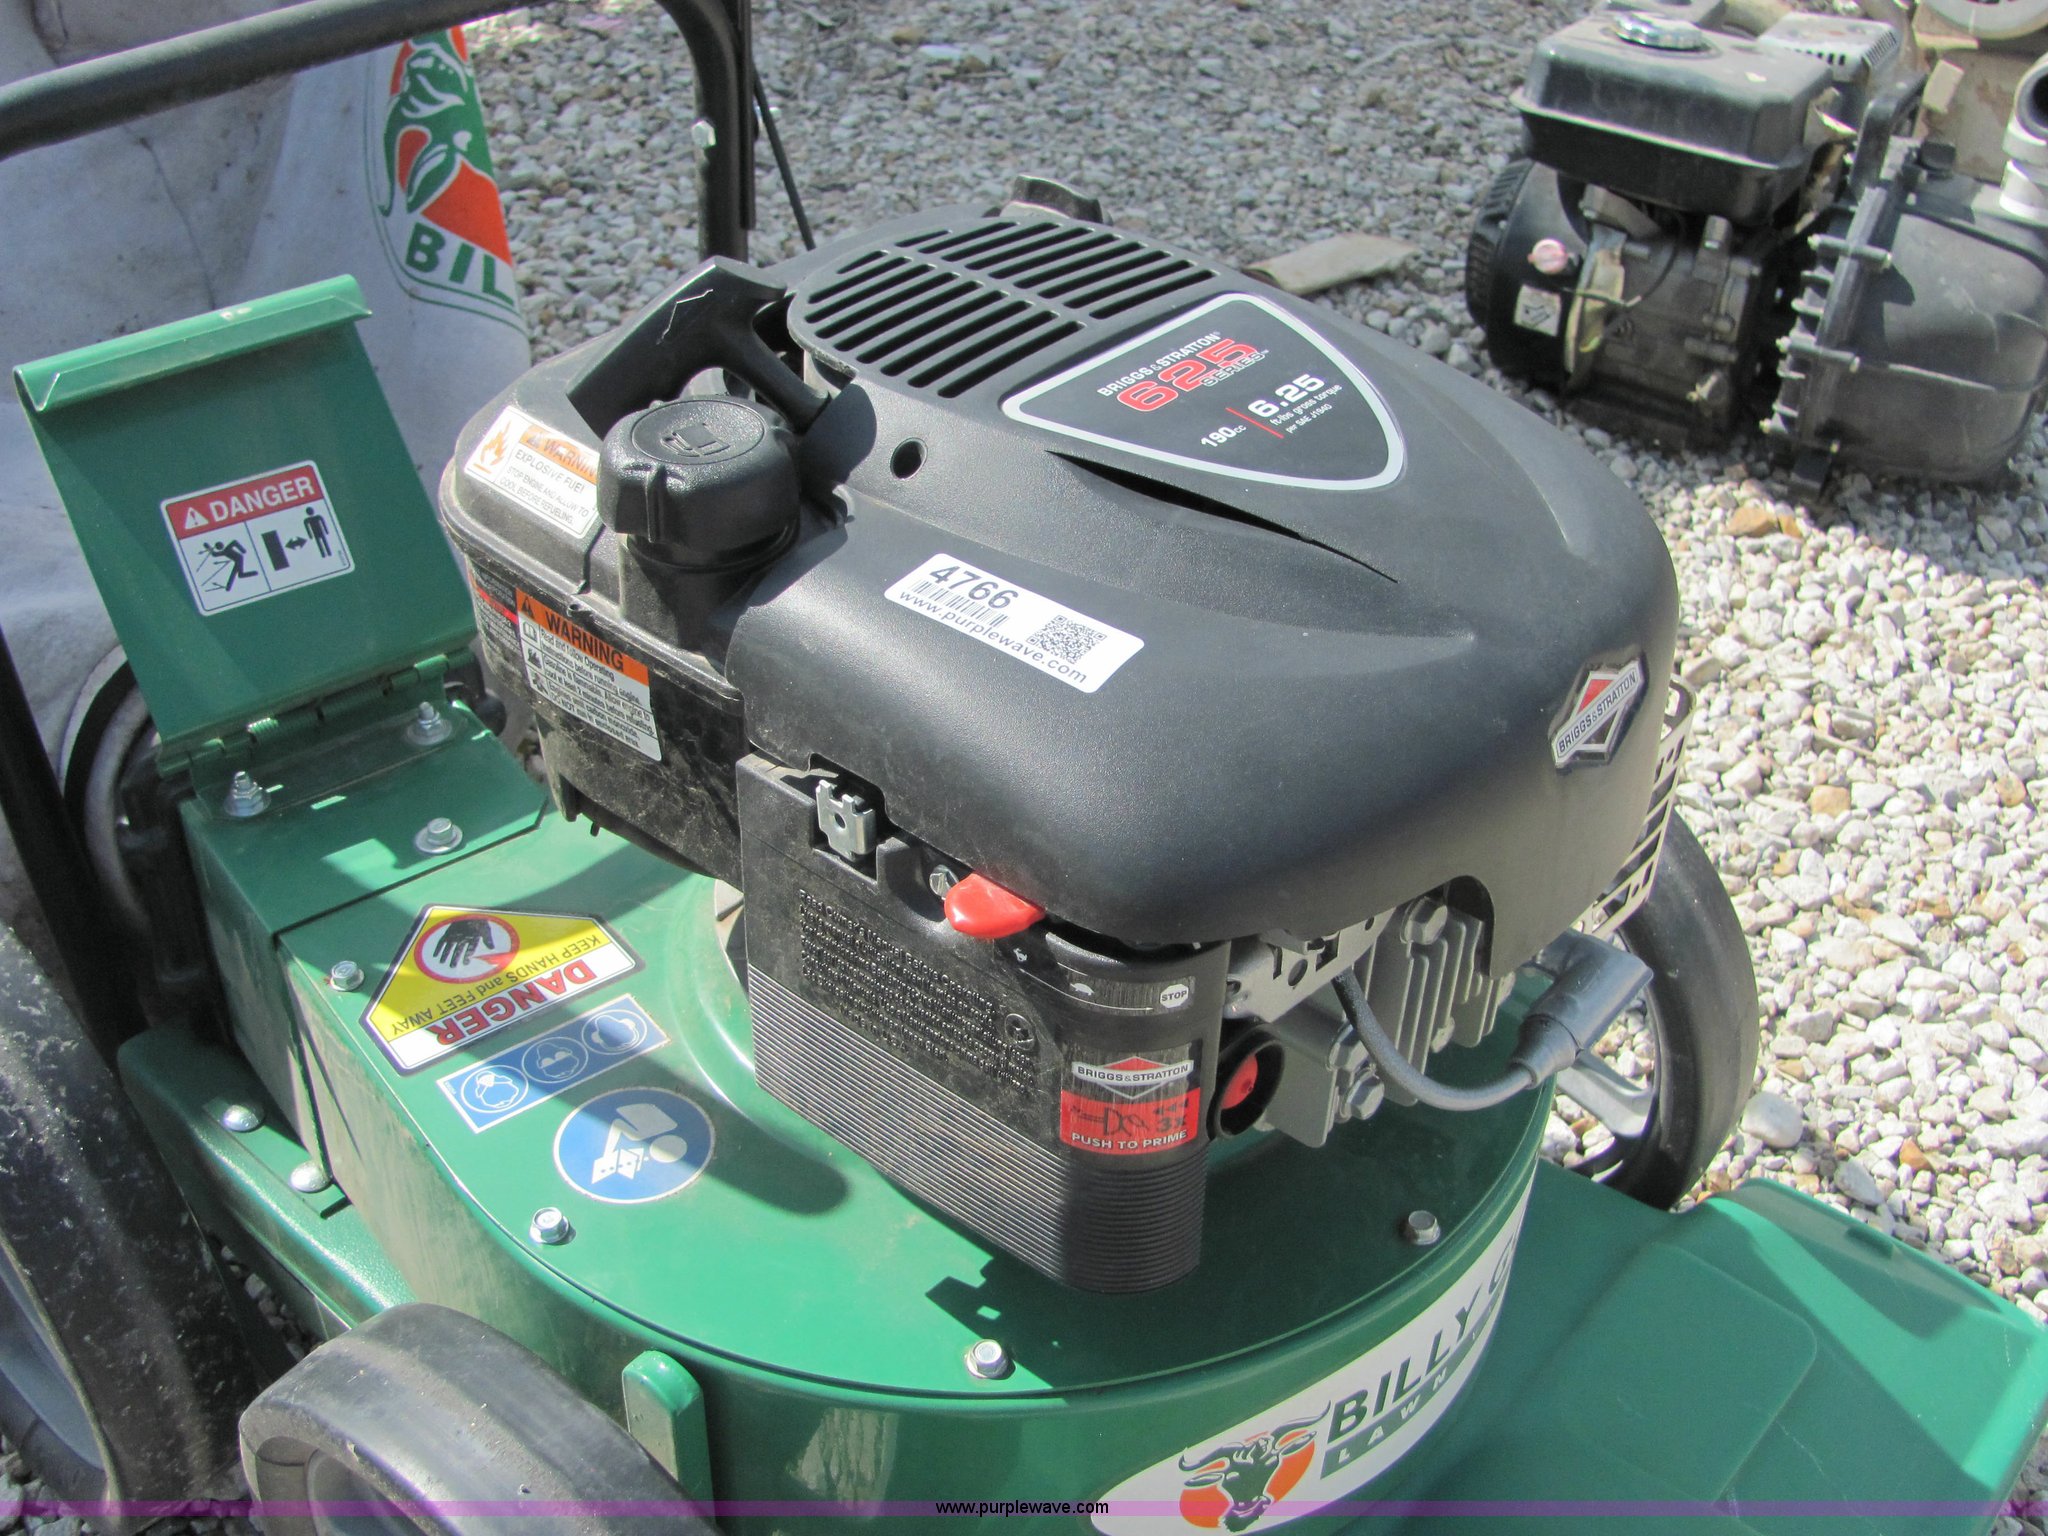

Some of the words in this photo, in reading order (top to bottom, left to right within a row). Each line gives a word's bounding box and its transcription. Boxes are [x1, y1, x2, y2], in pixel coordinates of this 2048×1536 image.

[1116, 338, 1258, 412] 625
[1201, 352, 1265, 387] SERIES
[1248, 373, 1325, 418] 6.25
[1293, 399, 1317, 415] gross
[1314, 384, 1342, 401] torque
[1286, 423, 1298, 434] per
[1296, 416, 1312, 426] SAE
[515, 449, 564, 481] EXPLOSIVE
[209, 476, 315, 522] DANGER
[930, 565, 1019, 609] 4766
[545, 611, 624, 672] WARNING
[899, 591, 1087, 683] www.purplewave.com
[1558, 671, 1637, 753] BRIGGS&STRATTON
[562, 935, 600, 962] KEEP
[799, 887, 823, 913] Read
[867, 928, 903, 962] Manual
[906, 952, 938, 983] Before
[477, 975, 505, 997] and
[505, 954, 560, 983] HANDS
[429, 958, 598, 1046] DANGER
[442, 989, 477, 1011] FEET
[1161, 989, 1187, 1001] STOP
[391, 1009, 434, 1037] AWAY
[1077, 1064, 1189, 1082] BRIGGS&STRATTON
[1071, 1132, 1112, 1149] PUSH
[1118, 1138, 1138, 1149] TO
[1143, 1129, 1187, 1148] PRIME
[1326, 1283, 1482, 1443] BILLY
[1337, 1367, 1448, 1464] LAWN
